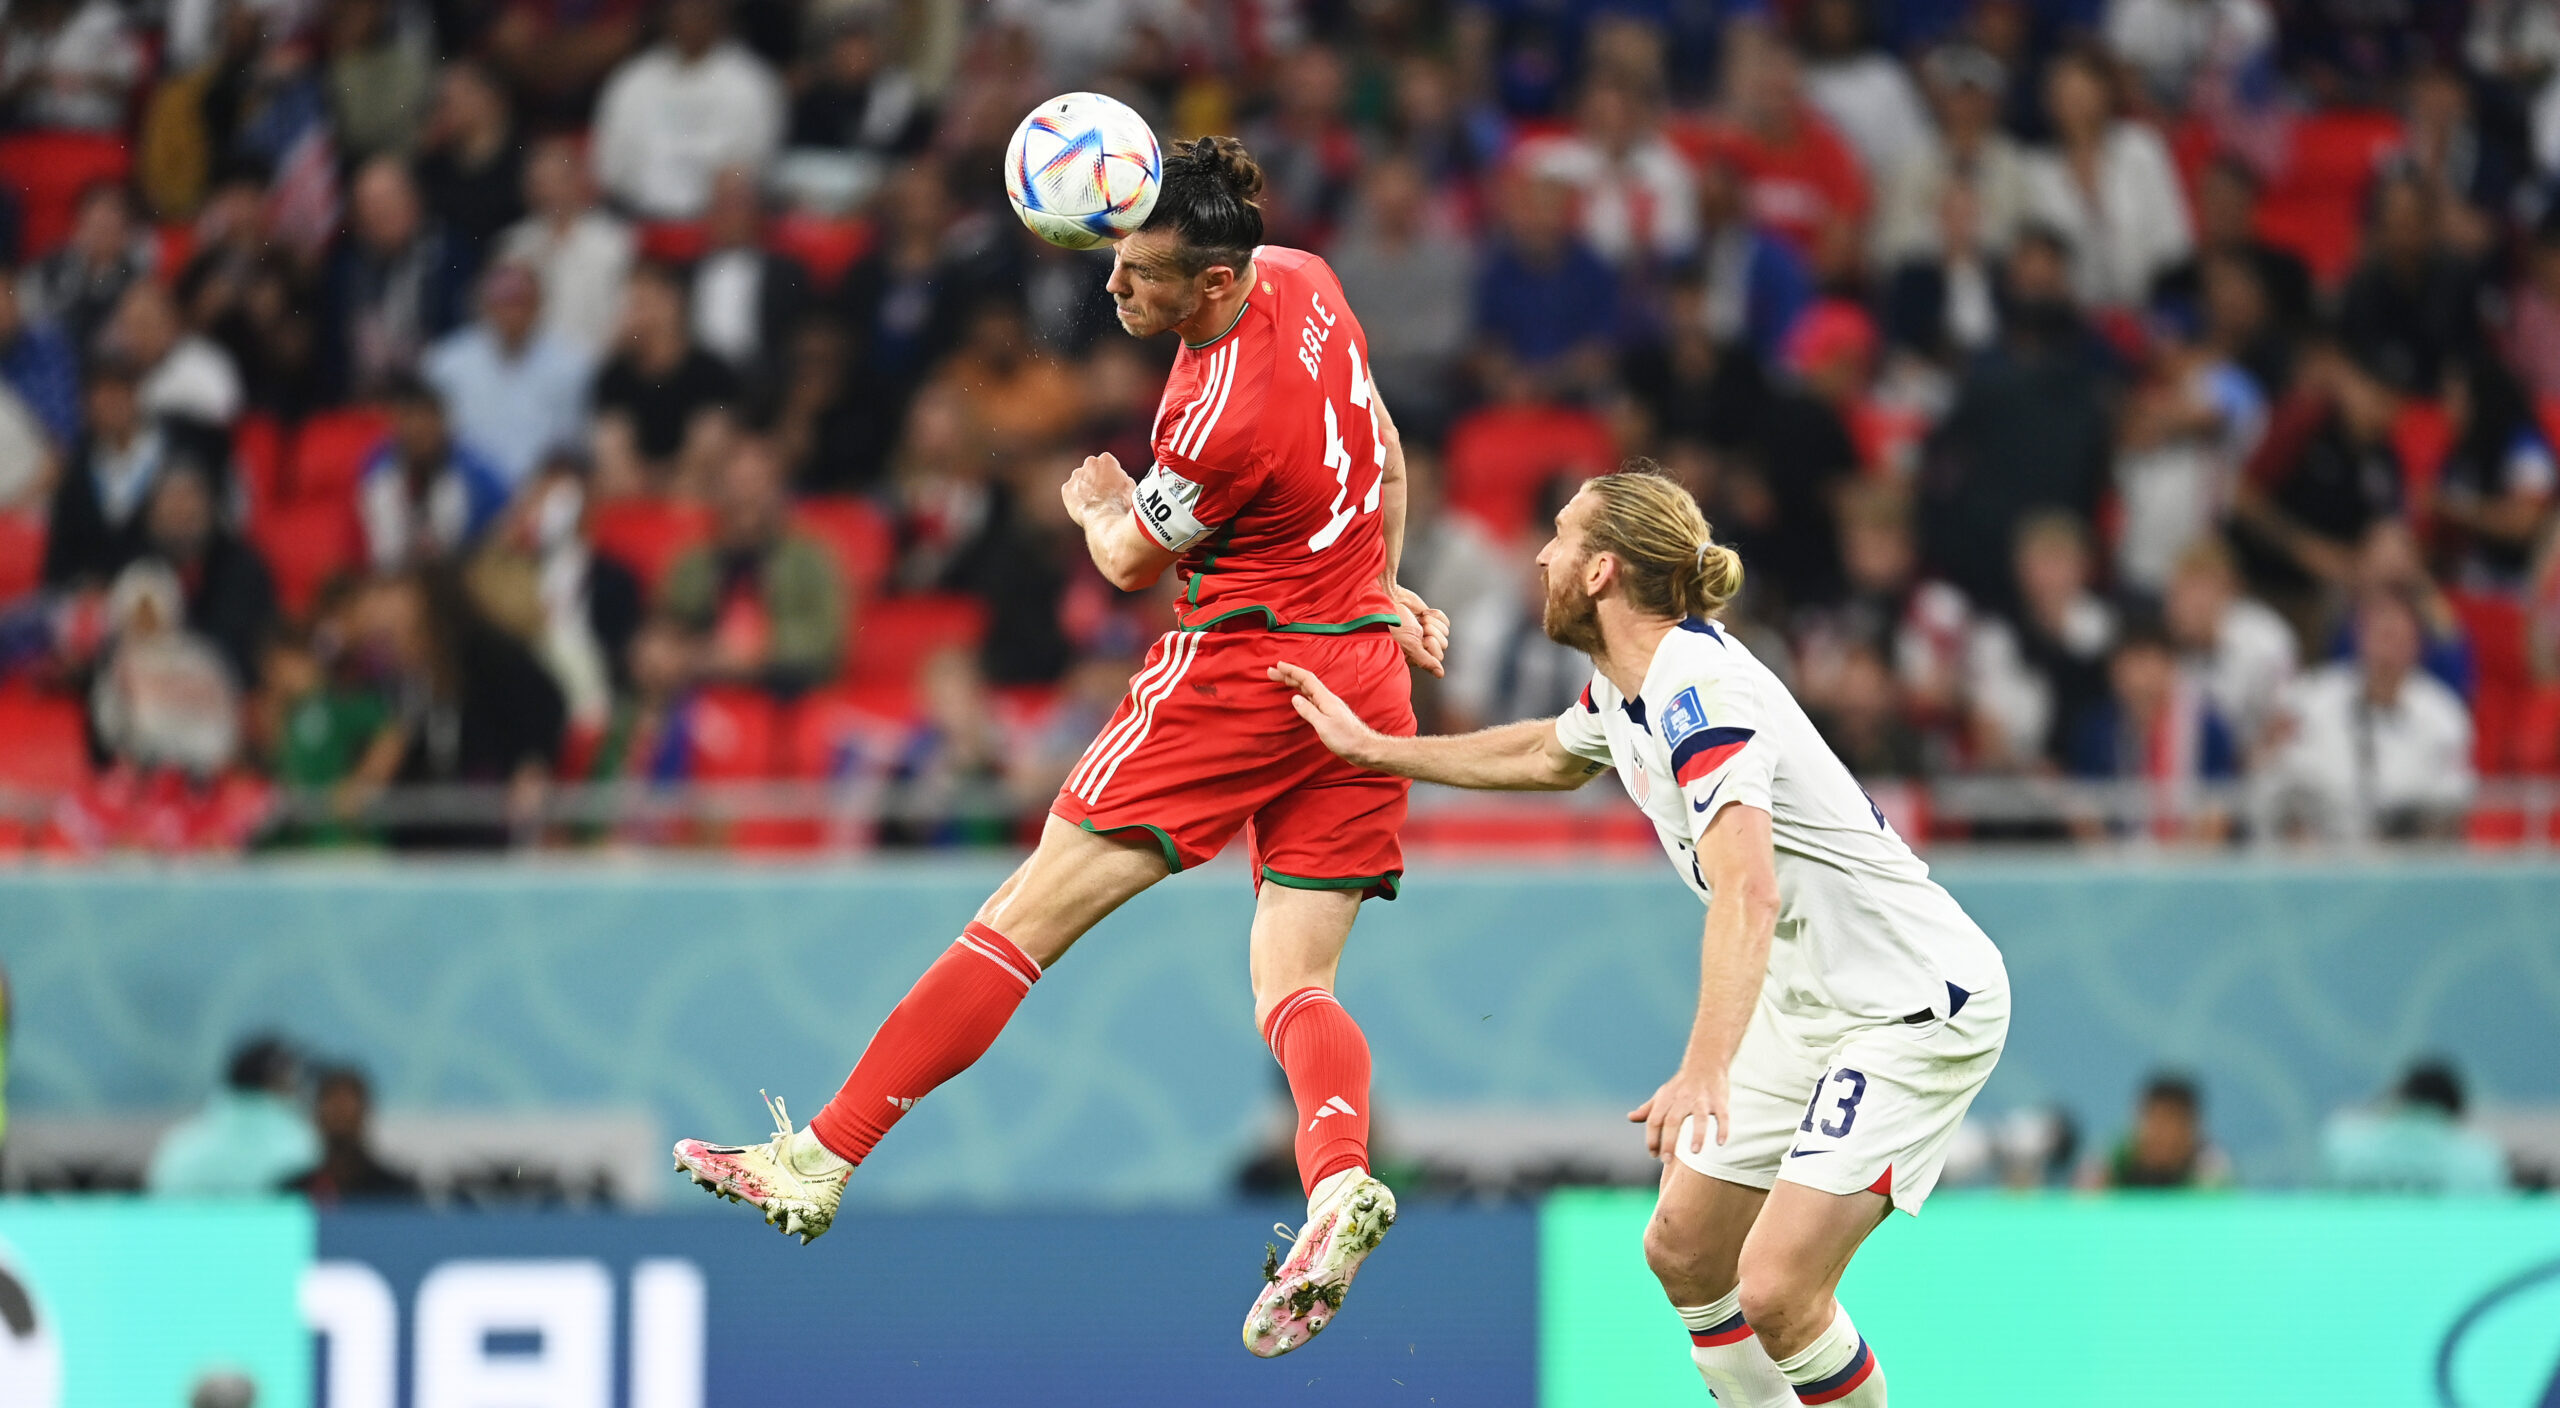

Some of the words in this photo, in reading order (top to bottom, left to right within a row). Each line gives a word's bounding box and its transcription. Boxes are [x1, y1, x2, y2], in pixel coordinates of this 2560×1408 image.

[1298, 291, 1337, 381] BALE
[1135, 488, 1173, 542] DISCRIMINATION
[1146, 489, 1172, 522] NO
[1800, 1066, 1867, 1139] 13
